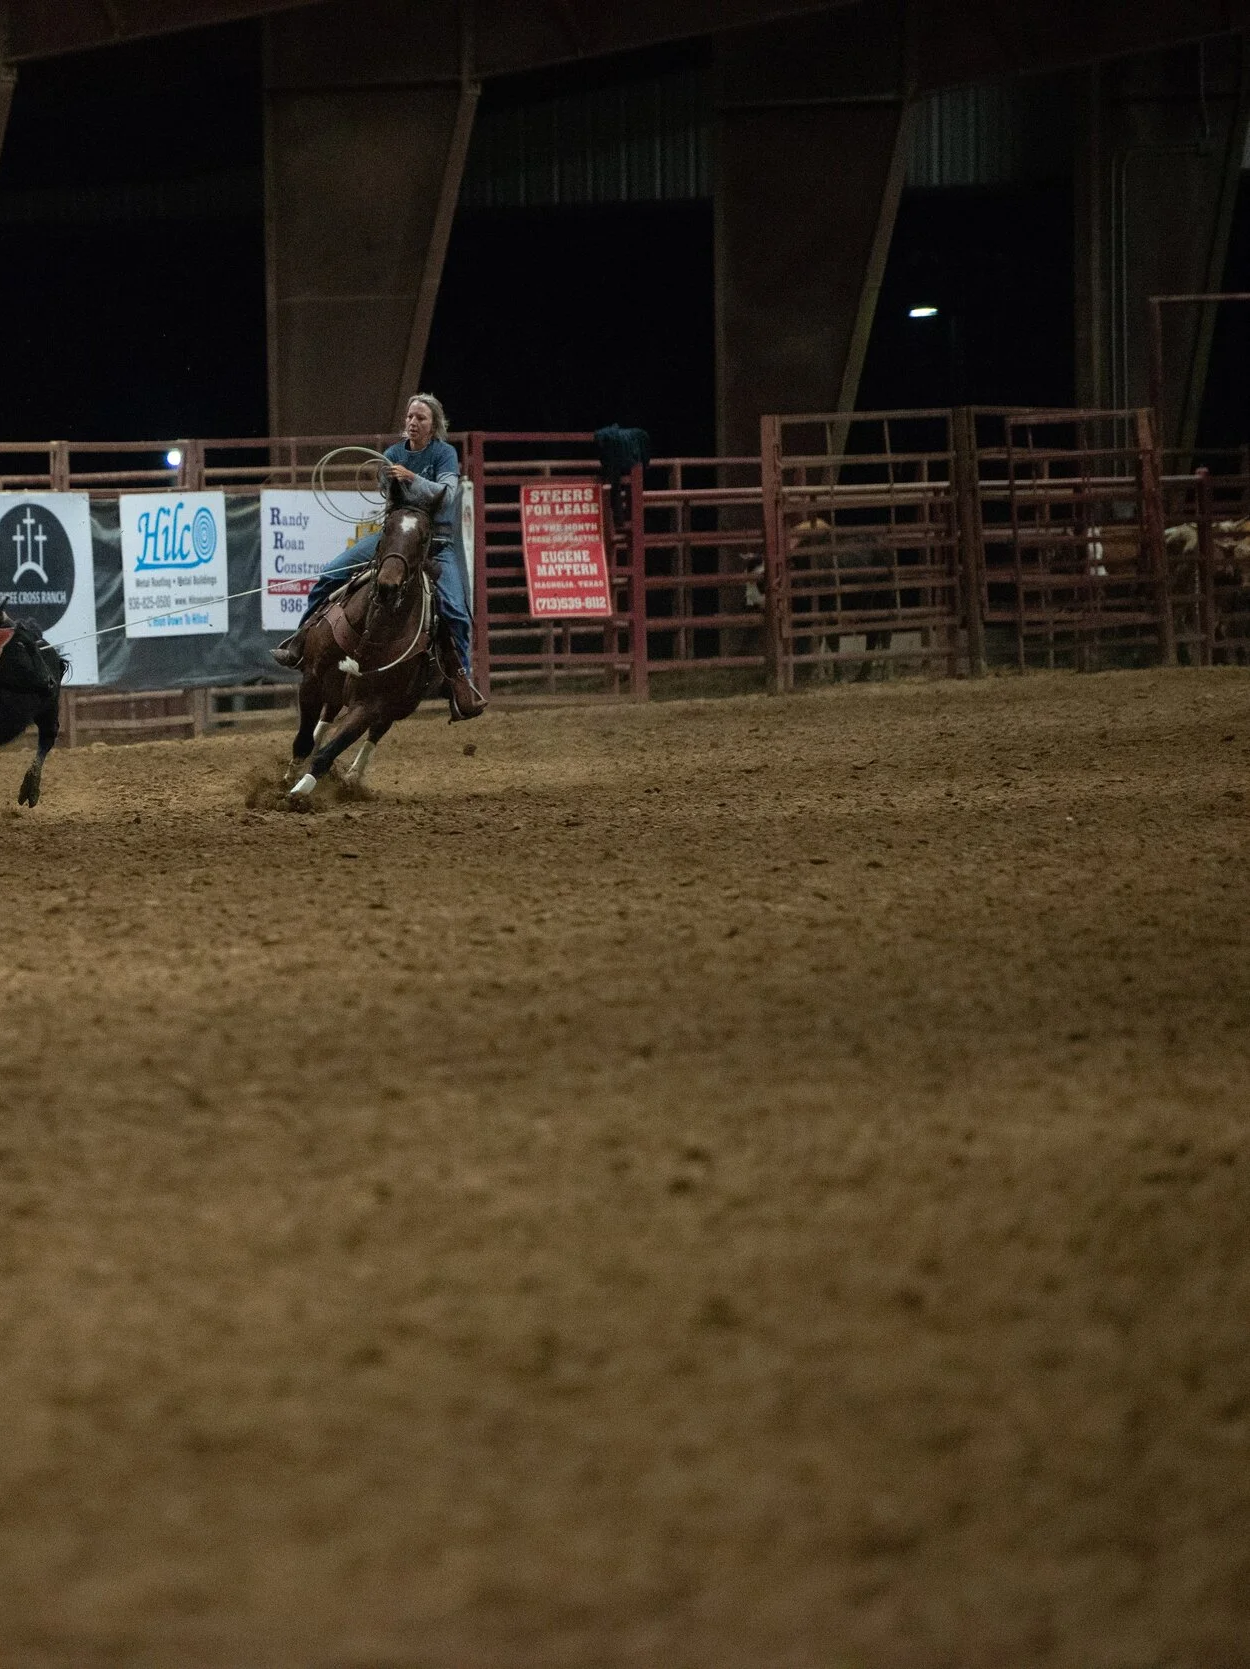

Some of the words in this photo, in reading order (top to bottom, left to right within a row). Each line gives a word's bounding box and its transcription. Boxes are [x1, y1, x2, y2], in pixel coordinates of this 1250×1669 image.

[530, 488, 593, 503] STEERS
[525, 504, 551, 516] FOR
[555, 503, 599, 516] LEASE
[270, 507, 309, 530] Randy
[564, 523, 598, 532] MONTH
[273, 531, 305, 550] Roan
[540, 550, 590, 563] EUGENE
[275, 555, 325, 574] Construc
[536, 563, 598, 576] MATTERN
[19, 591, 41, 604] CROSS
[41, 591, 66, 604] RANCH
